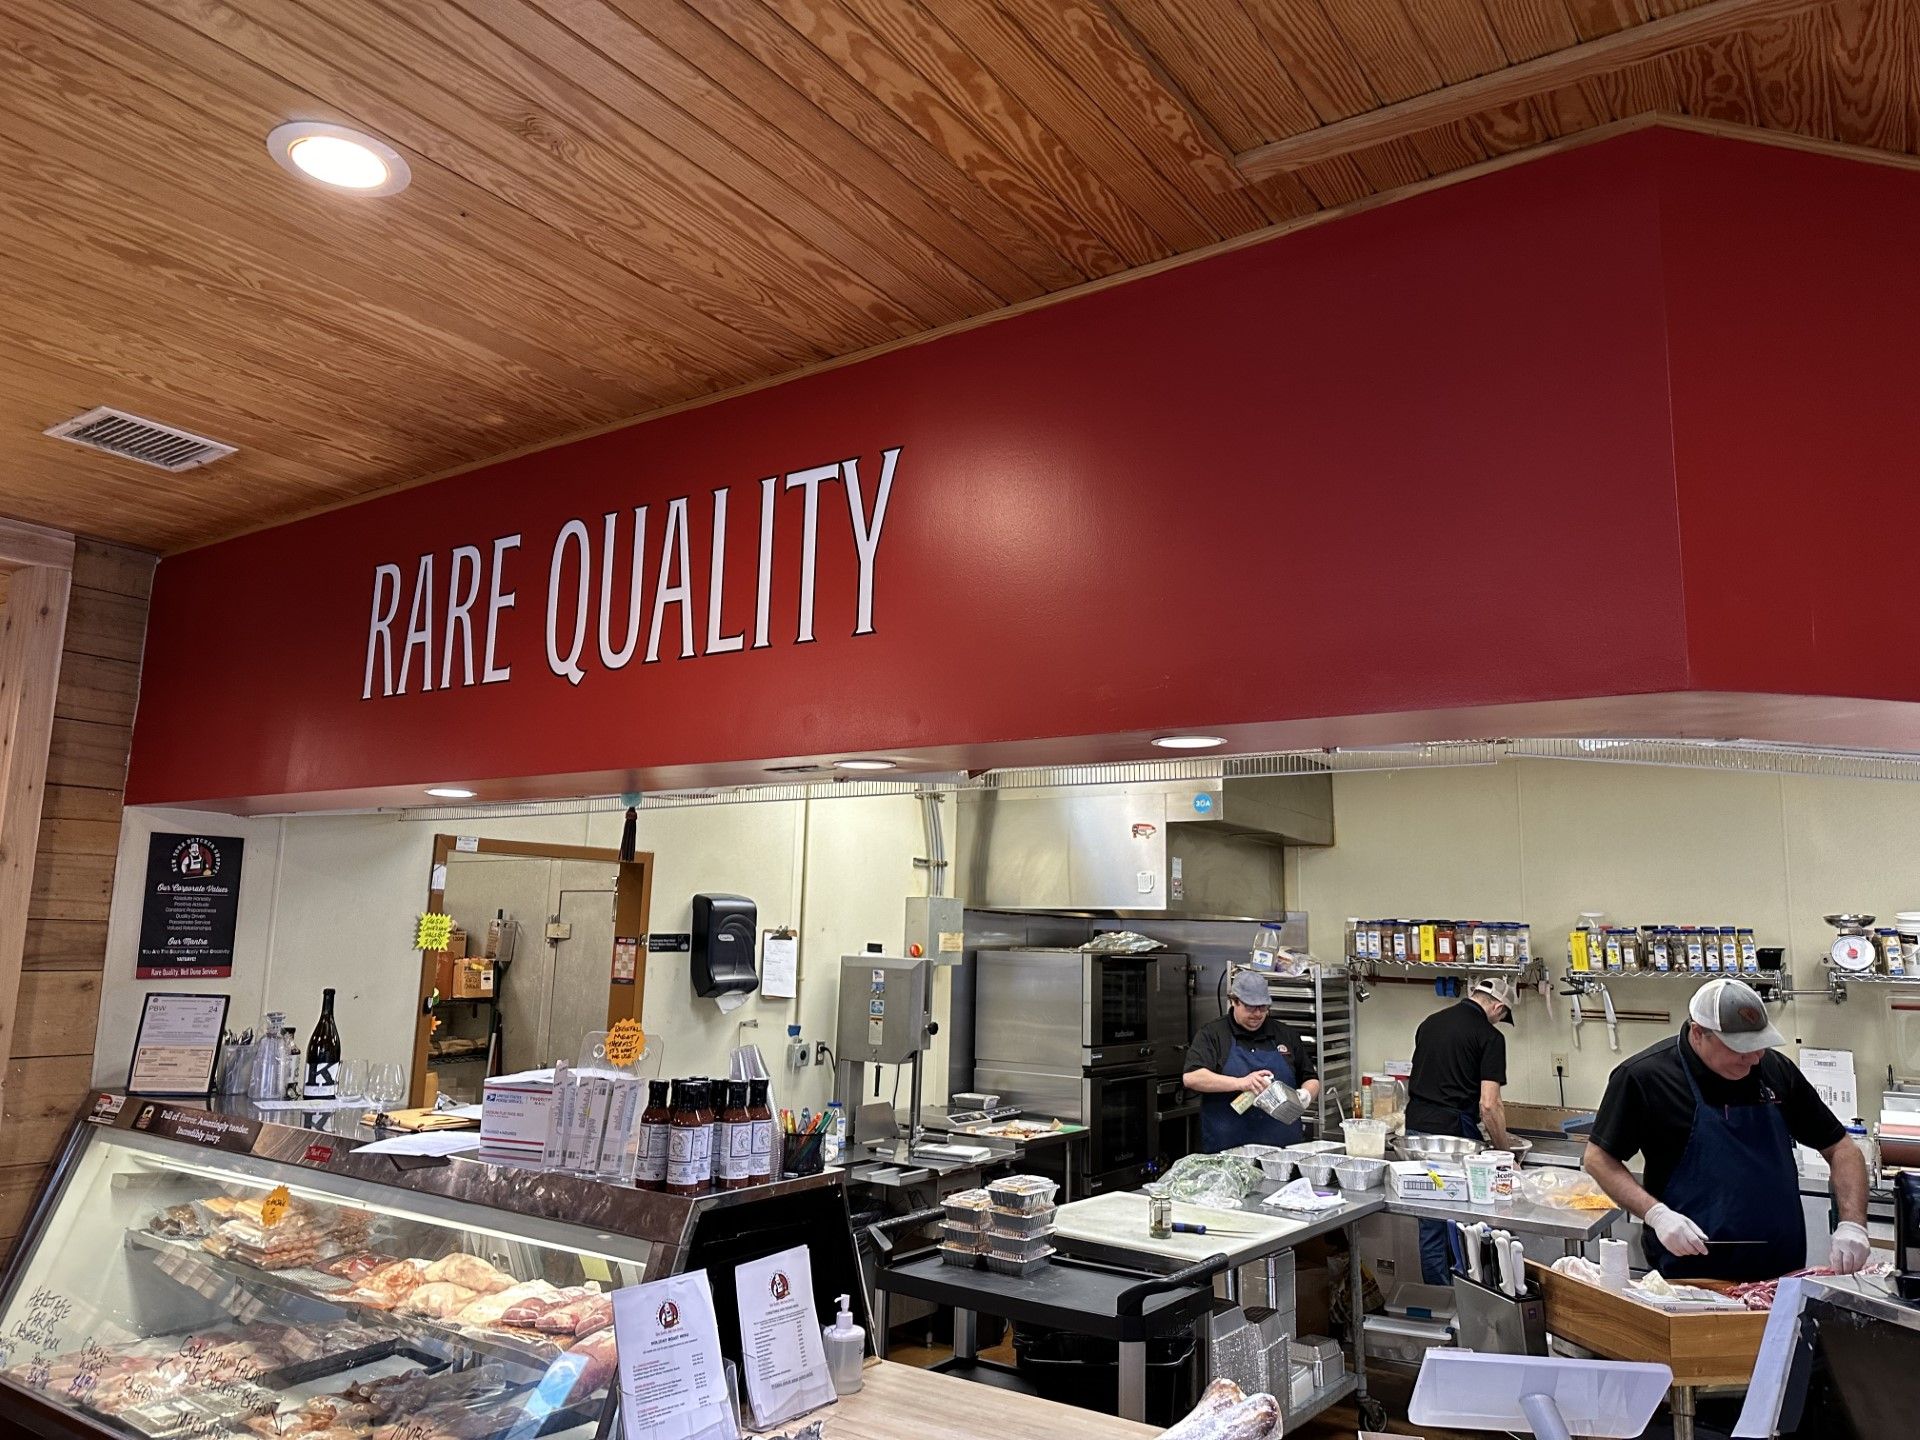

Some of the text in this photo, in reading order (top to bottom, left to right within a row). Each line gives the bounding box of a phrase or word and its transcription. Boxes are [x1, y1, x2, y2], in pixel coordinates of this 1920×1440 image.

[361, 446, 904, 700] RARE QUALITY
[157, 883, 229, 894] Our Corporate Values
[167, 937, 208, 946] Our Mantra
[151, 967, 219, 977] Rare Quality. Well Done Service.
[613, 1033, 637, 1041] MEAT
[305, 1062, 338, 1087] K
[161, 1109, 174, 1120] Full
[197, 1117, 229, 1132] Amazingly
[25, 1285, 72, 1319] HERITAGE
[179, 1335, 233, 1370] COLEMAN
